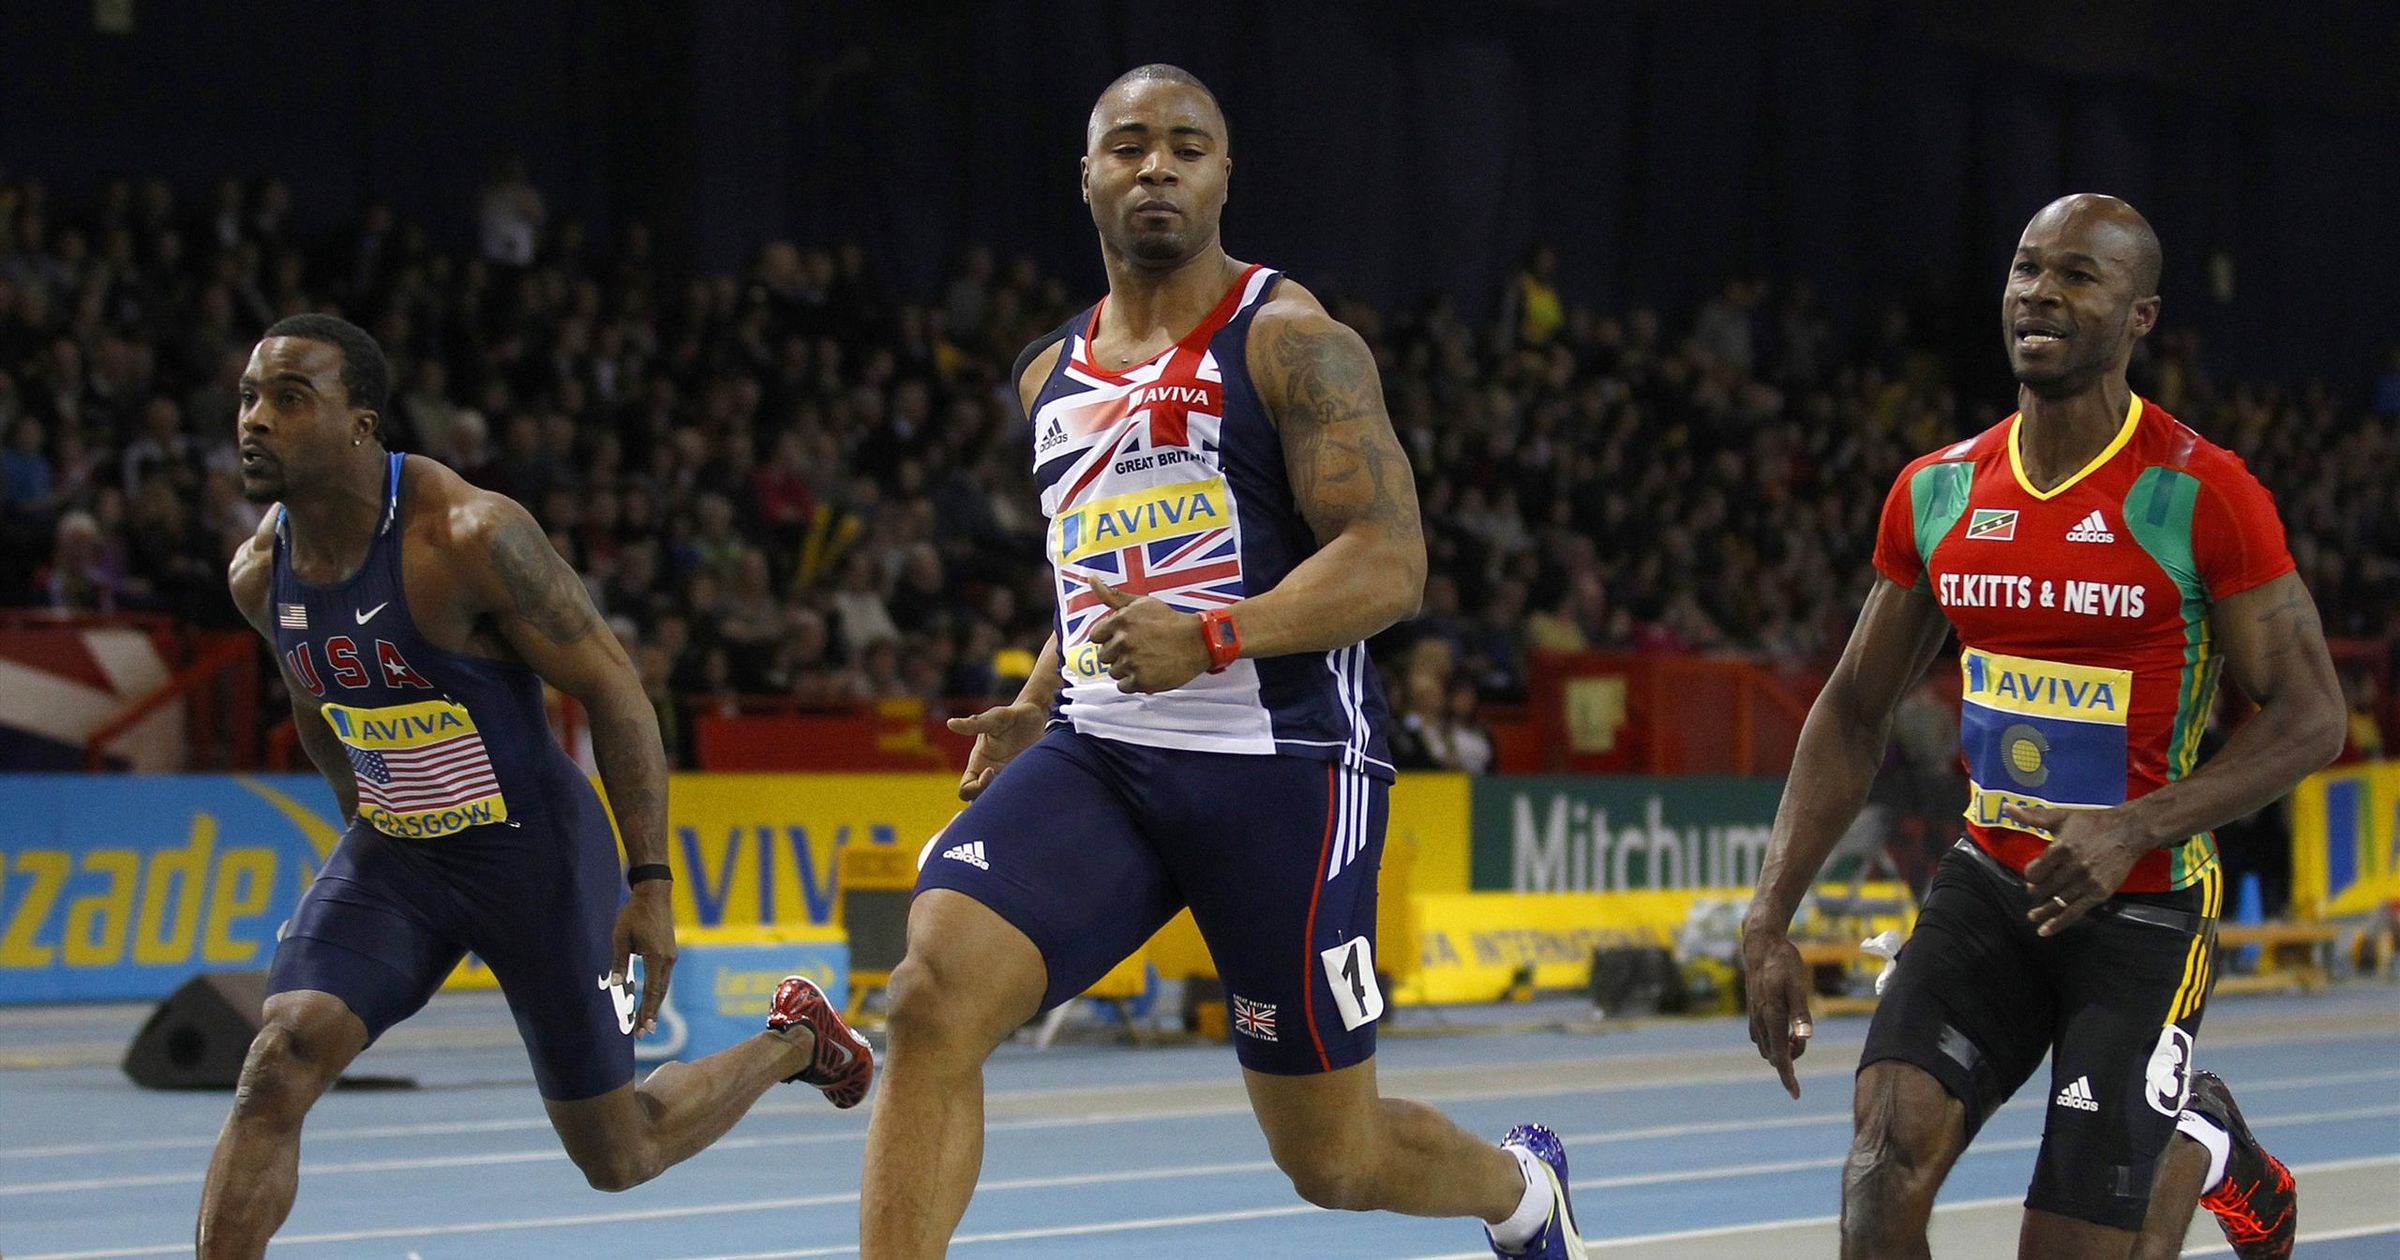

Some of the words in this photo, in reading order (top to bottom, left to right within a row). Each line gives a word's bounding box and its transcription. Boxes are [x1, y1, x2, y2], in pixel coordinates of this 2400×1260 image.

[1144, 385, 1209, 406] AVIVA
[1039, 433, 1069, 453] adidas
[1115, 457, 1154, 475] GREAT
[1095, 492, 1217, 542] AVIVA
[2065, 530, 2115, 544] adidas
[1939, 572, 2033, 609] ST.KITTS
[2039, 580, 2056, 608] &
[2063, 580, 2146, 619] NEVIS
[286, 635, 435, 698] USA
[1996, 671, 2116, 711] AVIVA
[362, 710, 464, 741] AVIVA
[942, 849, 990, 871] adidas
[1511, 794, 1772, 893] Mitchum
[0, 811, 278, 968] zade
[676, 822, 897, 928] VIV
[1341, 942, 1369, 1018] 1
[2159, 1032, 2188, 1111] 3
[2056, 1094, 2099, 1112] adidas
